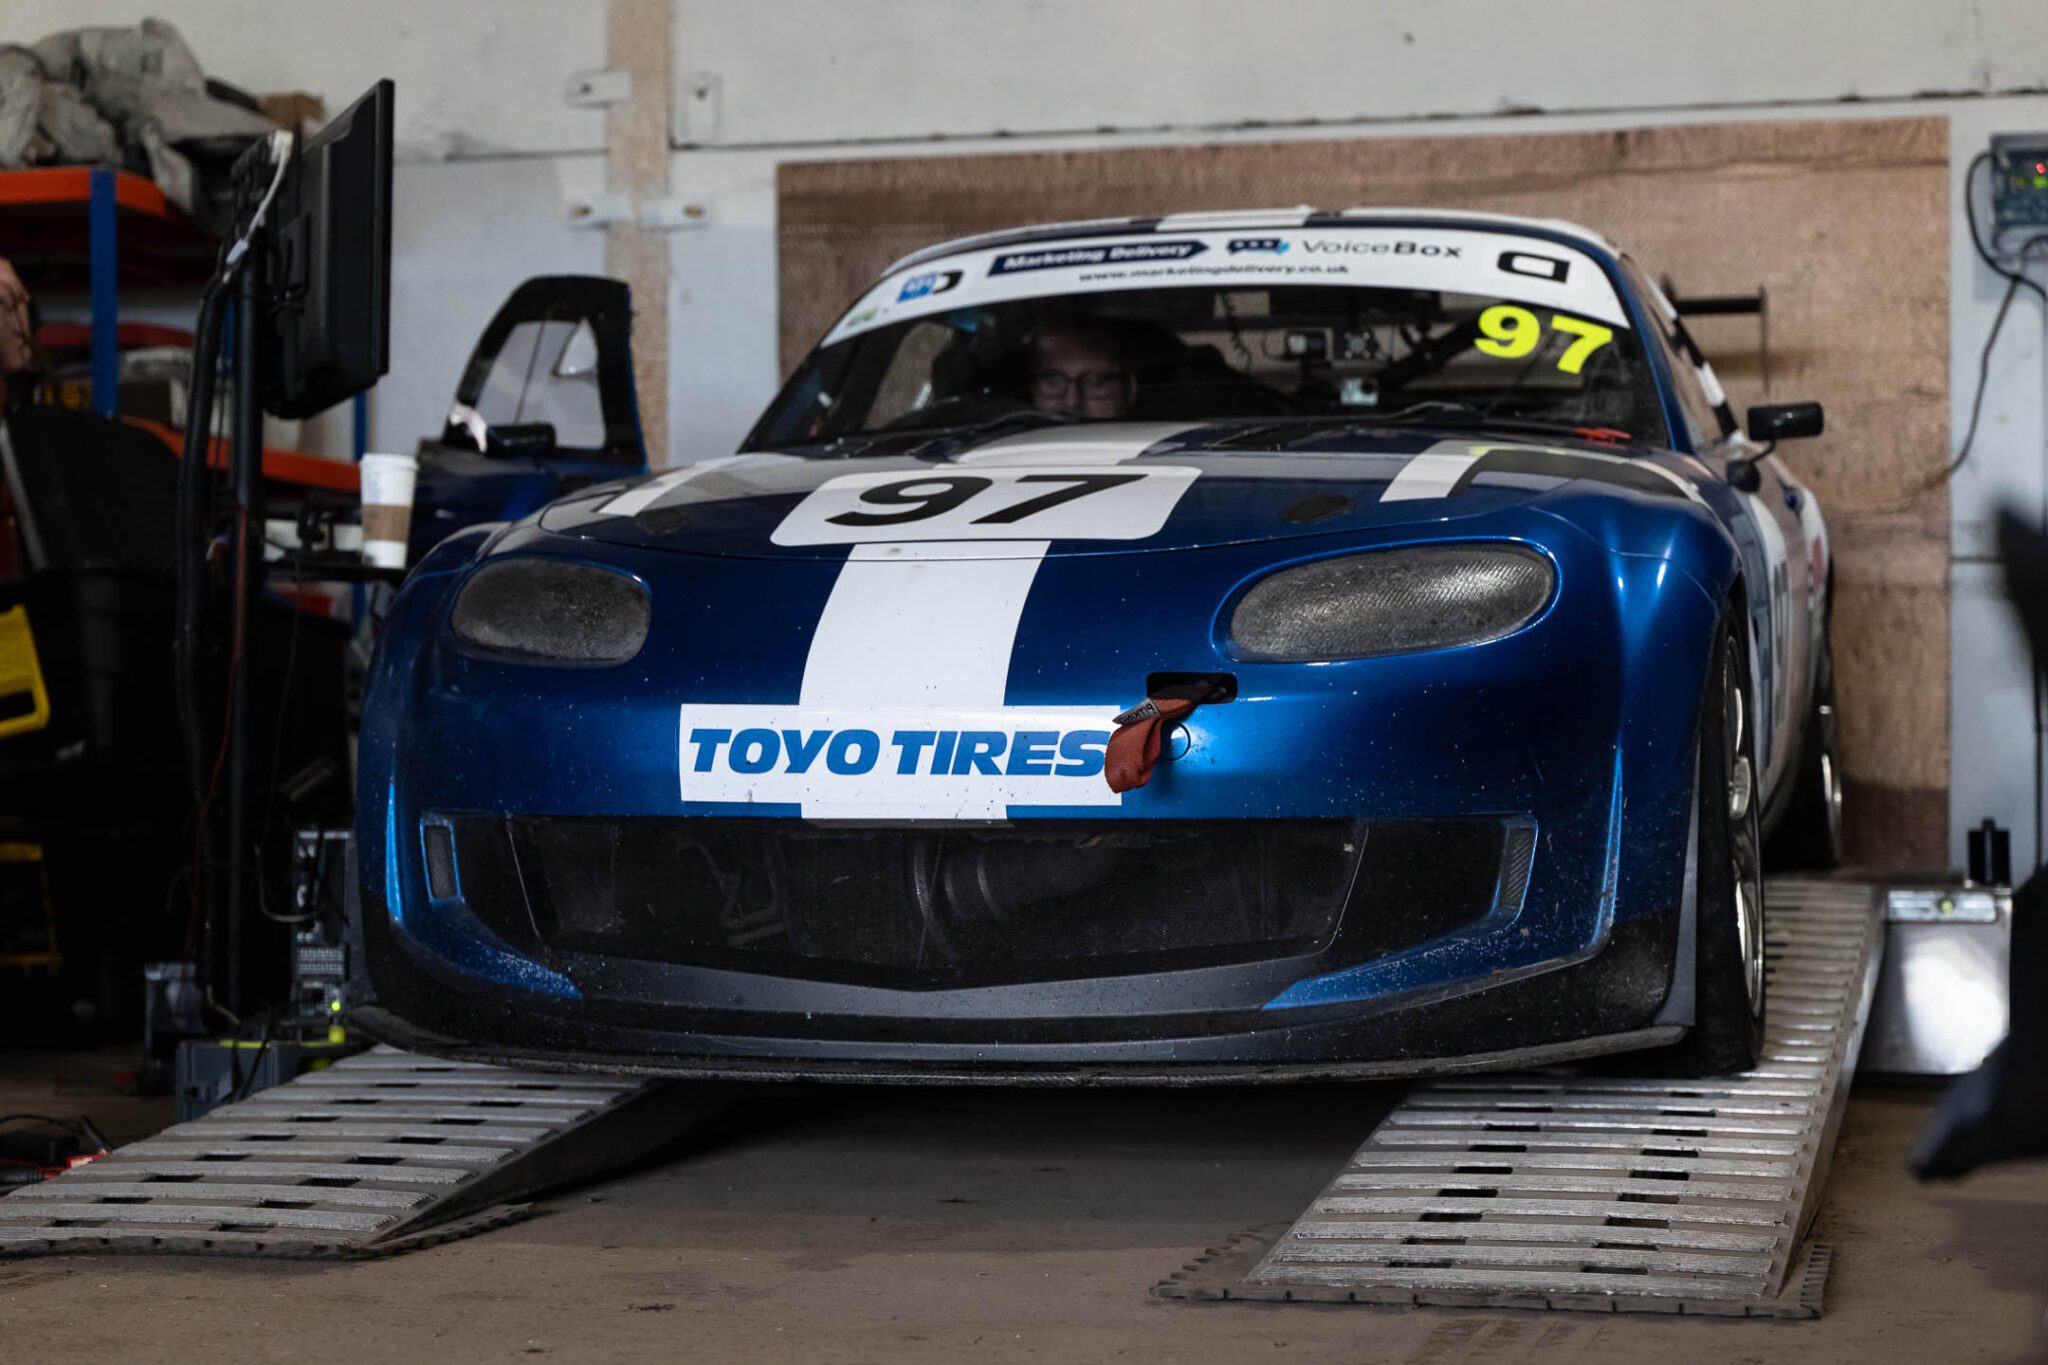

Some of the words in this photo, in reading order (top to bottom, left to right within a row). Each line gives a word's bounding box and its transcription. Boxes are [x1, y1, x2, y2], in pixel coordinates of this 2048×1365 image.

[1003, 249, 1106, 270] Marketing
[1108, 243, 1192, 261] Delivery
[1303, 240, 1462, 259] VoiceBox
[1474, 305, 1613, 375] 97
[824, 473, 1150, 527] 97
[688, 728, 880, 776] TOYO
[892, 730, 1110, 778] TIRES
